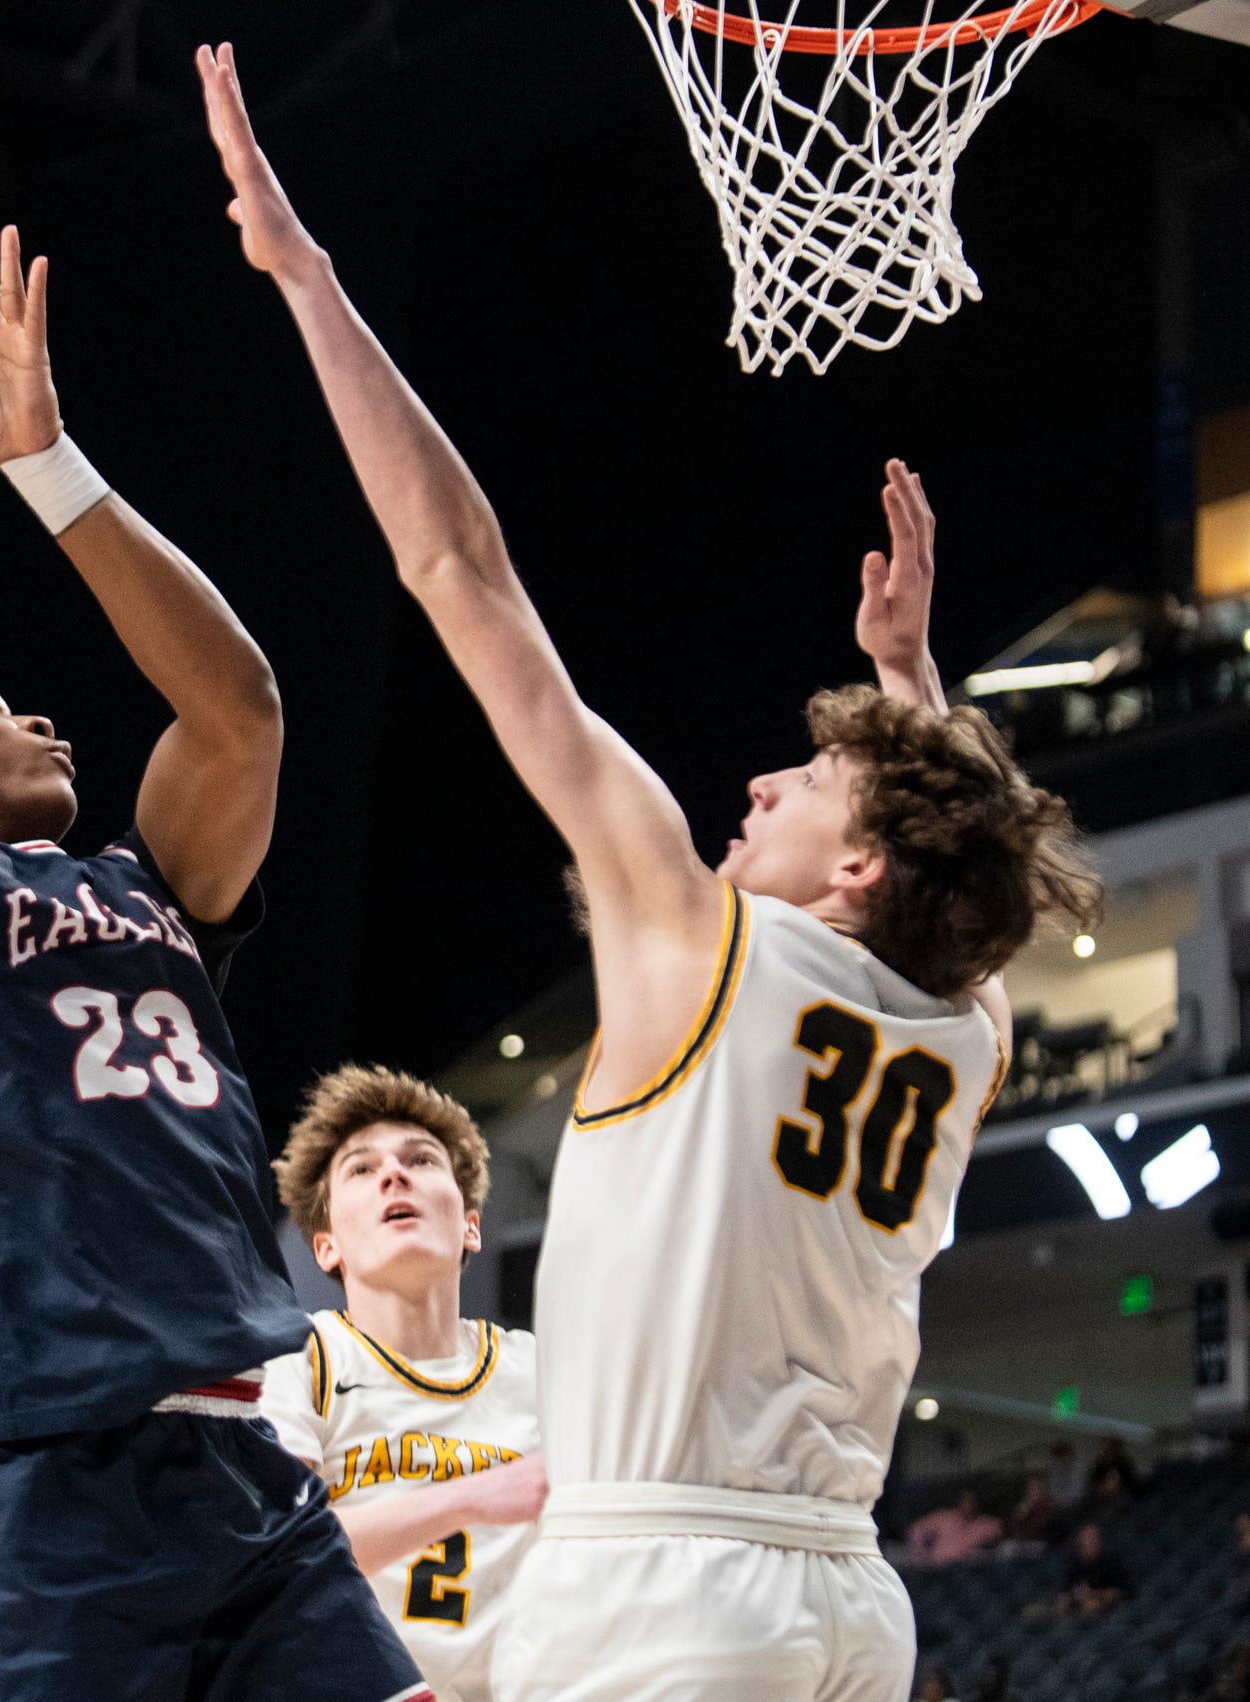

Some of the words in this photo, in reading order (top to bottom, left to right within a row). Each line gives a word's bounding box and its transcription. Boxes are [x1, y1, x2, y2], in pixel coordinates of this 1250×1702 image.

[50, 985, 220, 1109] 23
[771, 998, 958, 1236] 30
[403, 1528, 471, 1628] 2
